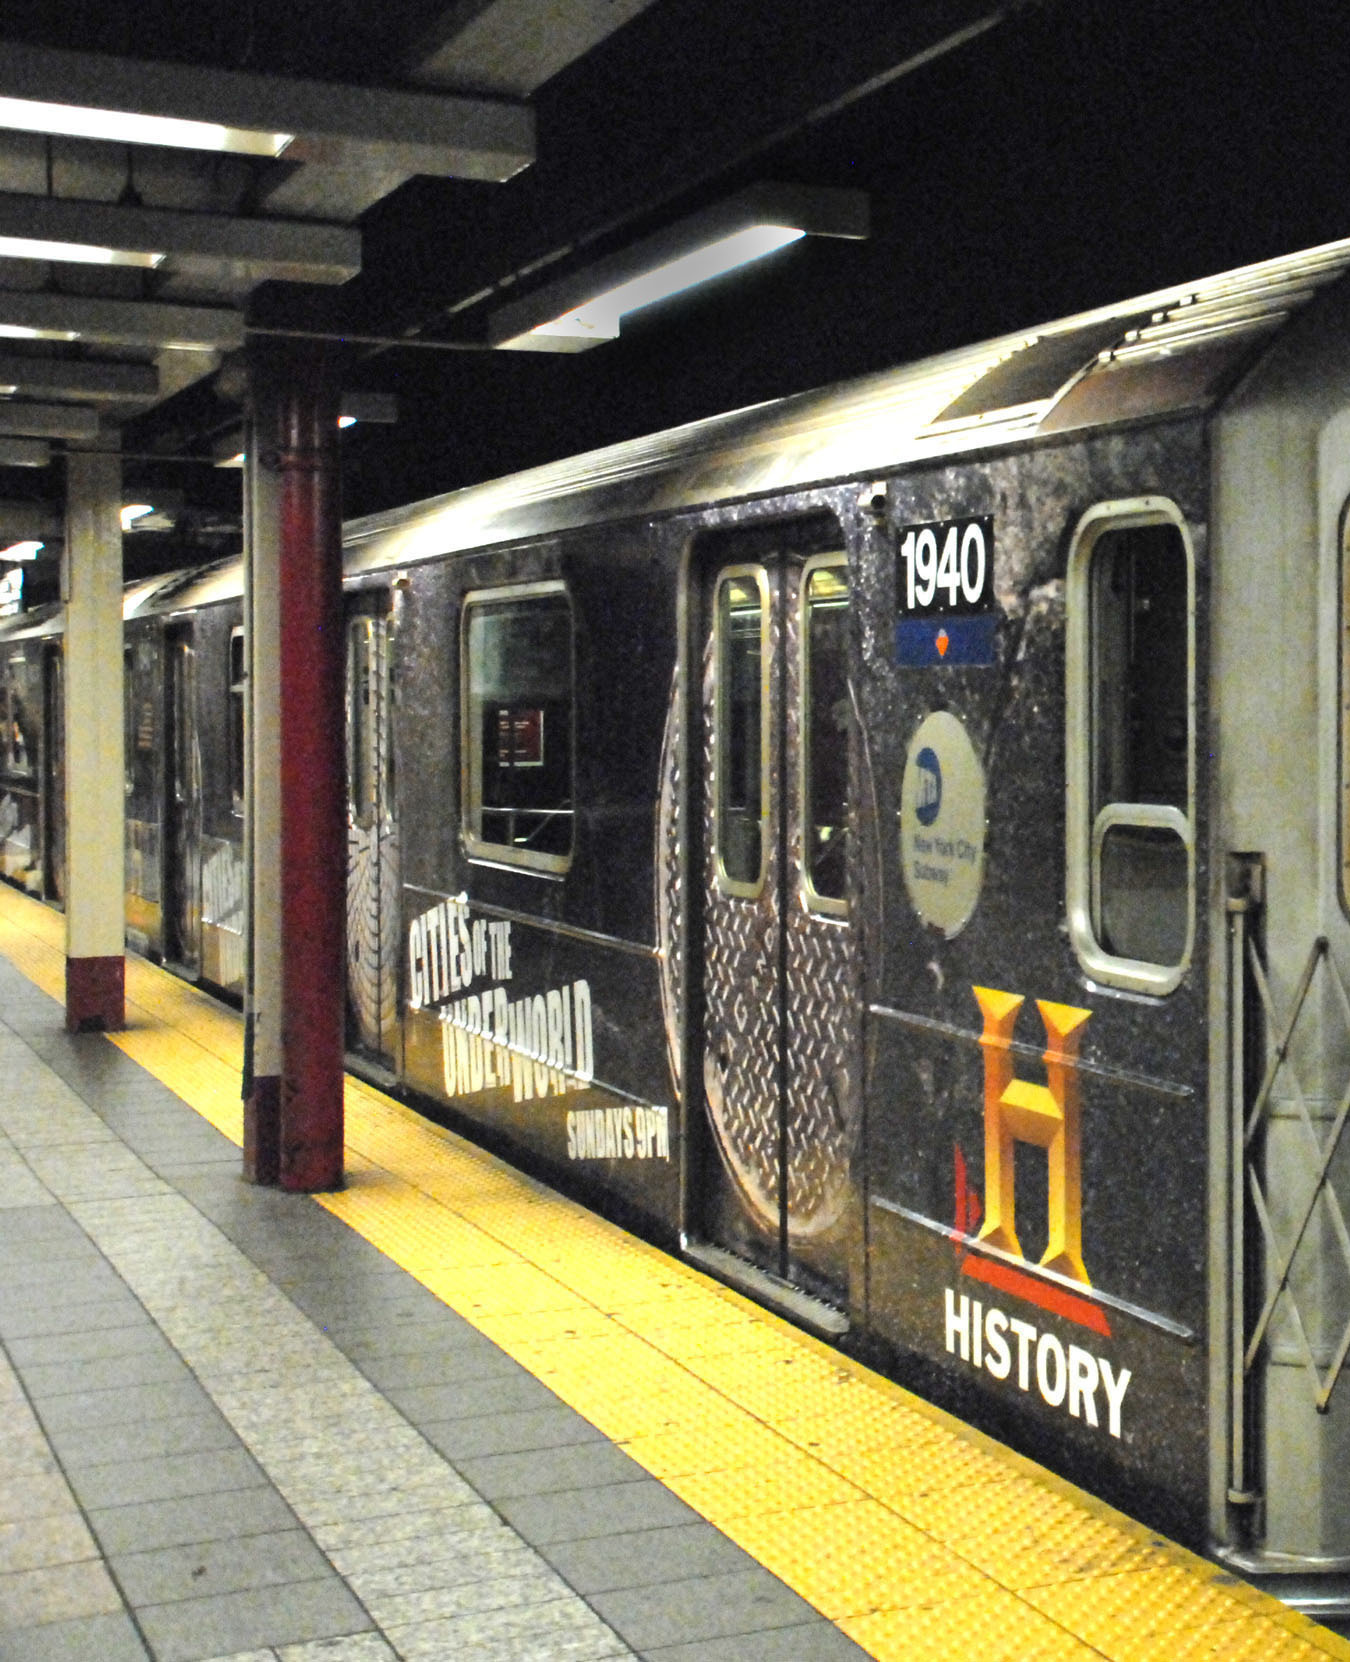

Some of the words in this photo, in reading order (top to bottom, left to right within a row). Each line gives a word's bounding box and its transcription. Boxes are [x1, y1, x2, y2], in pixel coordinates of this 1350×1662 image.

[901, 522, 986, 610] 1940
[957, 839, 977, 866] City
[409, 898, 472, 1009] CITIES
[473, 919, 487, 976] OF
[489, 921, 512, 980] THE
[440, 979, 594, 1103] UNDERWORLD
[567, 1106, 634, 1160] SUNDAYS
[635, 1106, 670, 1162] 9PM
[944, 1288, 1132, 1439] HISTORY
